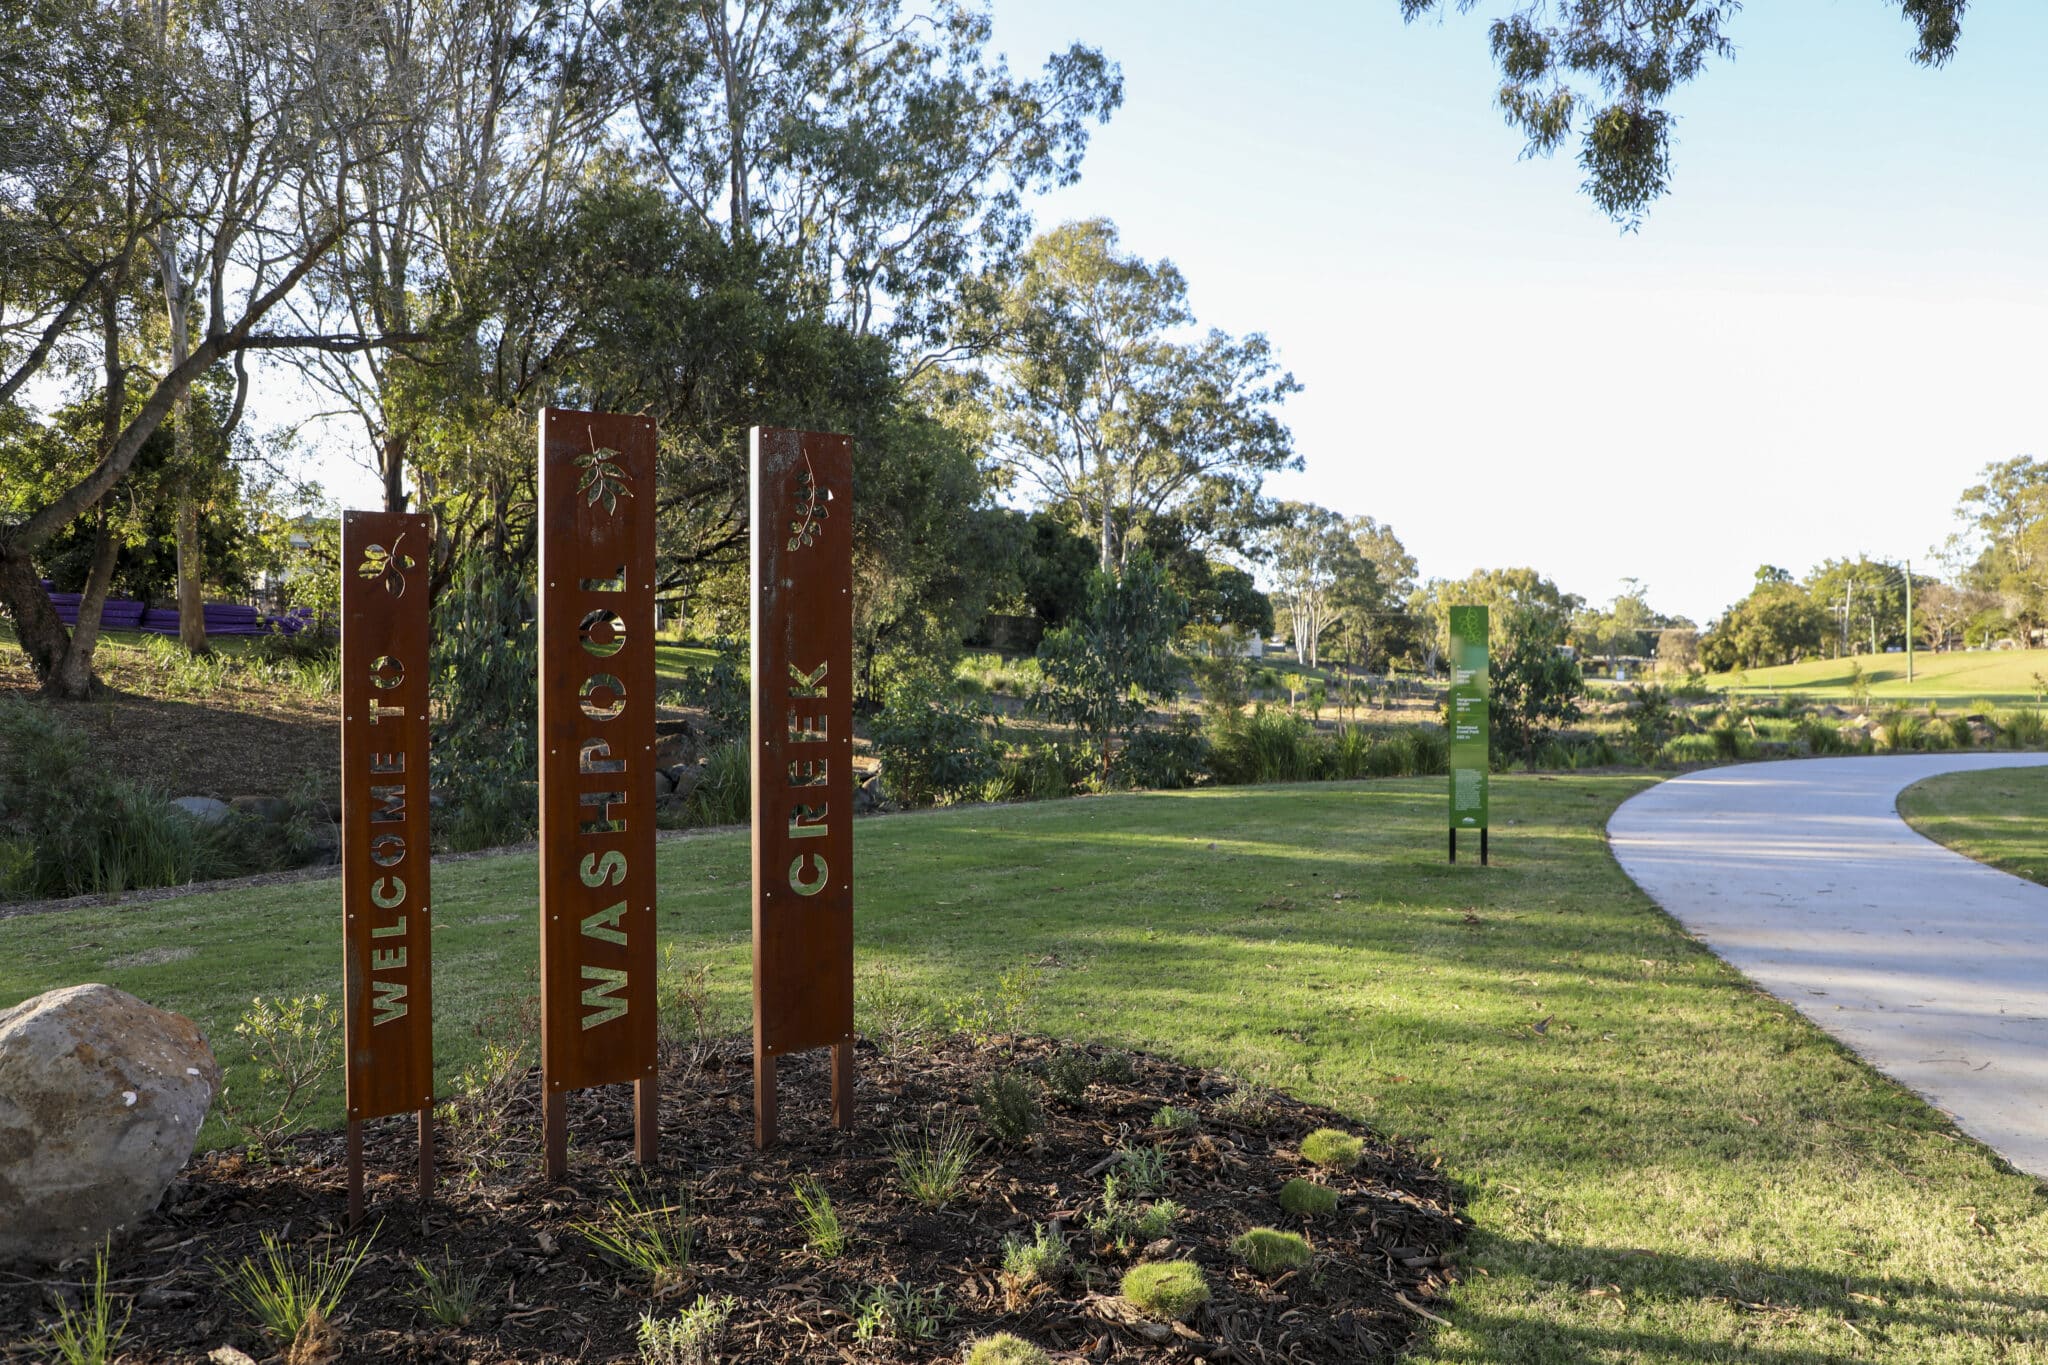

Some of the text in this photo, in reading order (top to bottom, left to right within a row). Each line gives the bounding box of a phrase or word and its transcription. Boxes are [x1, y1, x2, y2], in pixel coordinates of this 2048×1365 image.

[369, 655, 408, 1027] WELCOME TO
[579, 564, 629, 1031] WASHPOOL
[787, 660, 829, 897] CREEK
